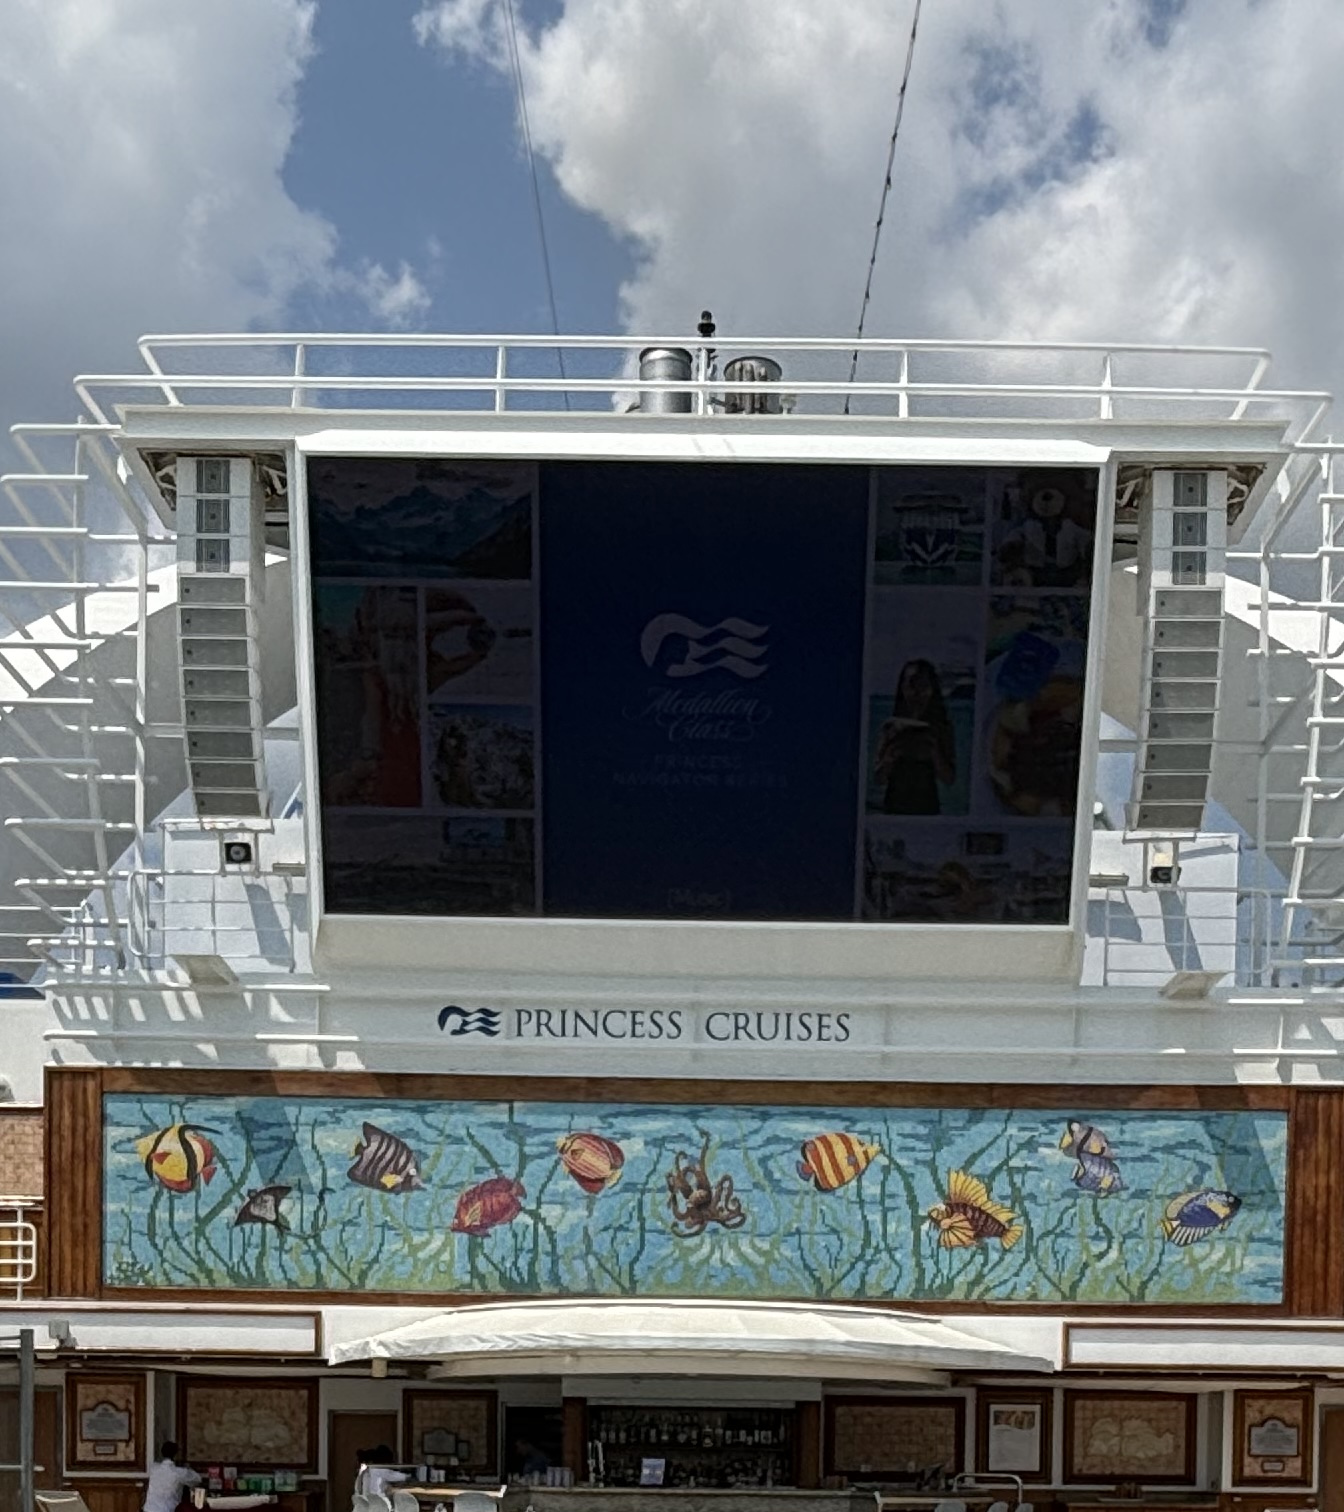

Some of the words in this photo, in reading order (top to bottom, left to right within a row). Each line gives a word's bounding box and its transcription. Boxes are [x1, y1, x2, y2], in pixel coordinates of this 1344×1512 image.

[622, 687, 771, 724] Medallion
[656, 716, 754, 742] Class
[514, 1009, 682, 1039] PRINCESS
[705, 1012, 851, 1042] CRUISES
